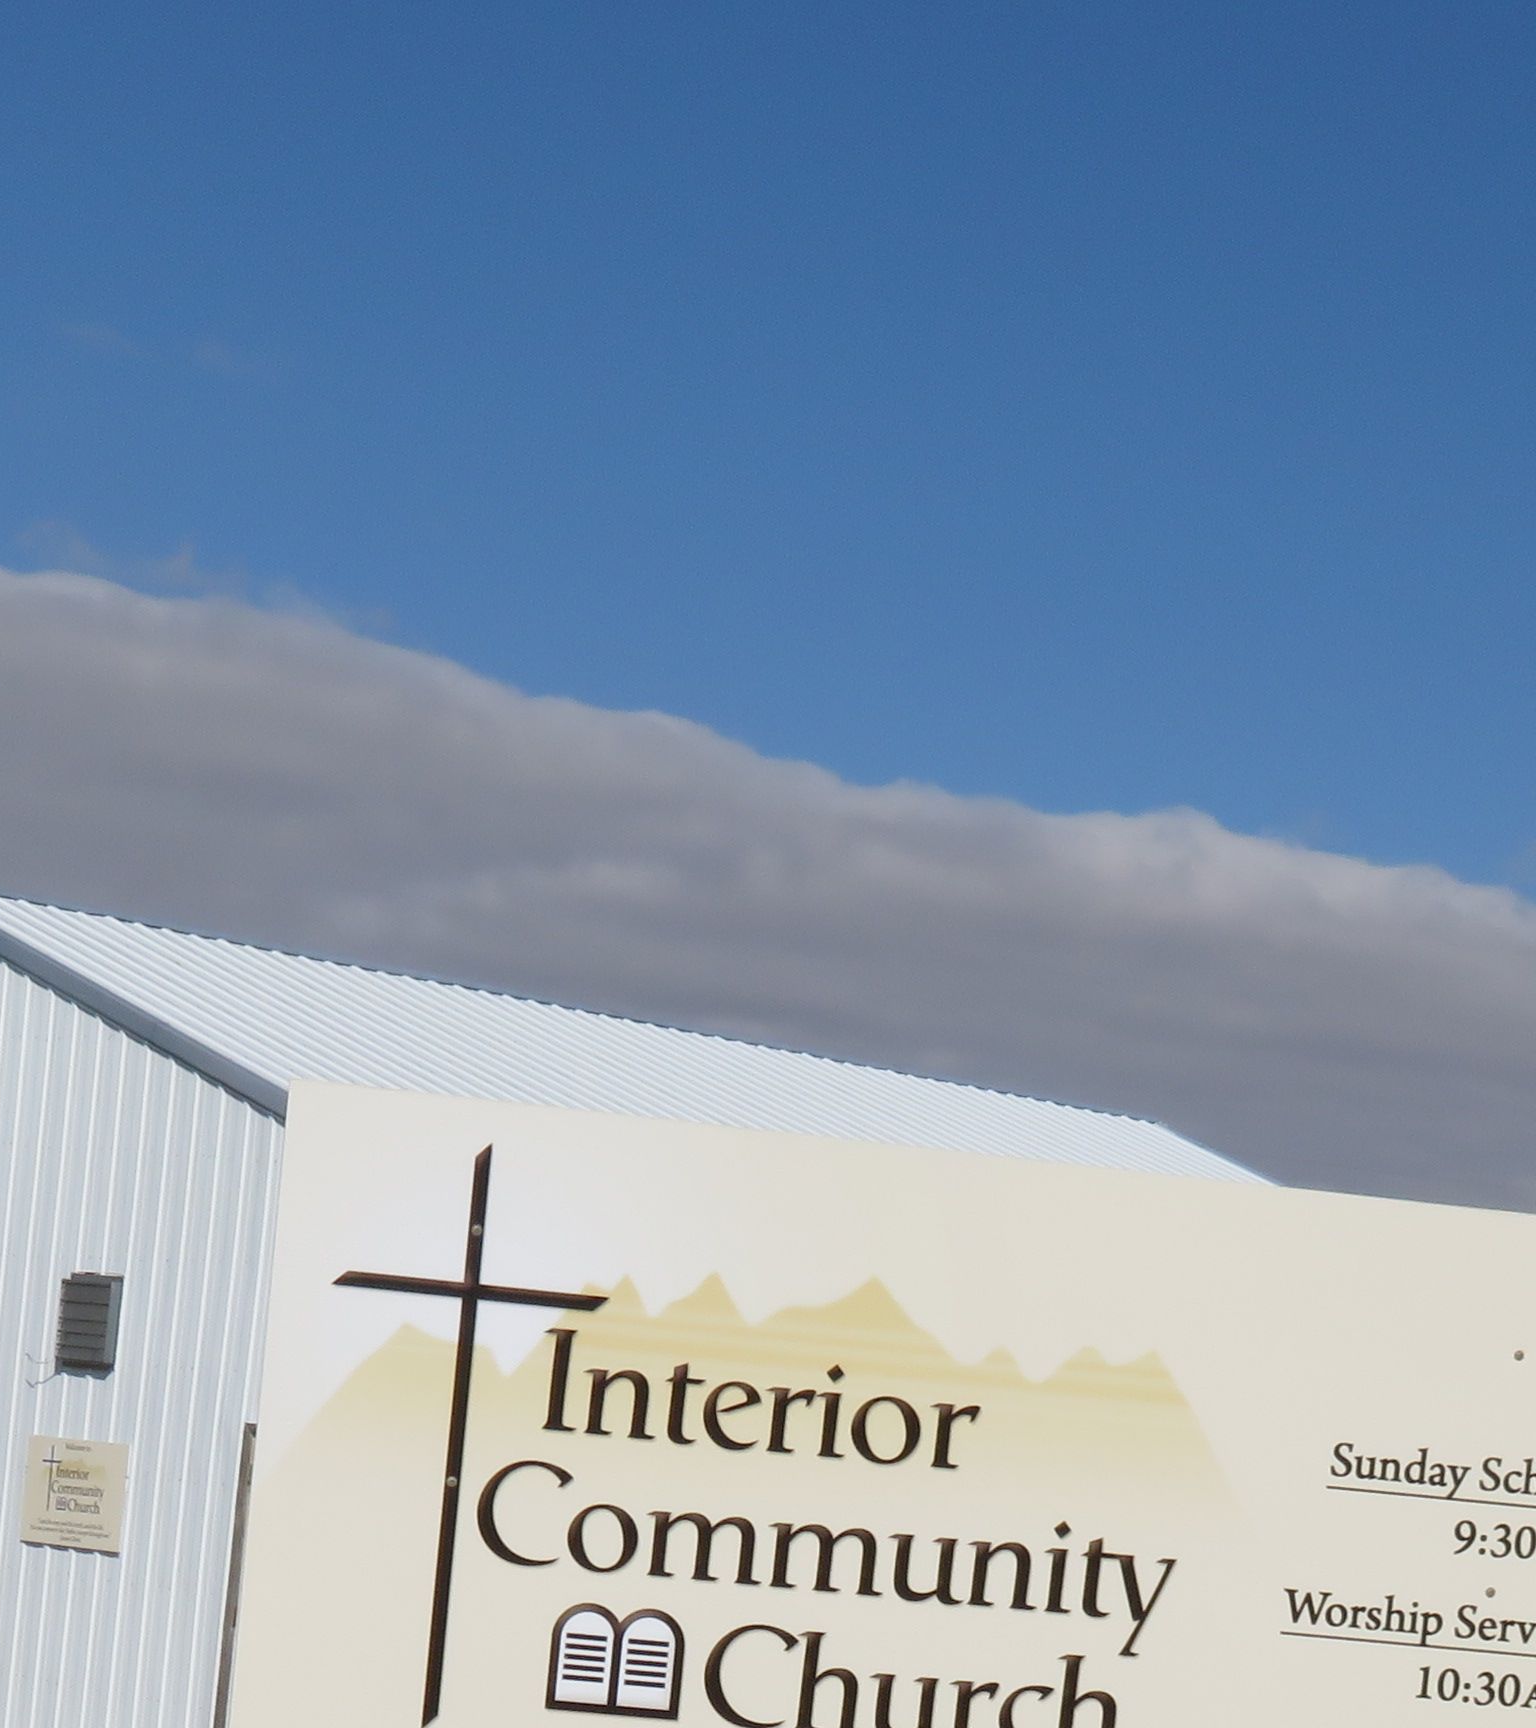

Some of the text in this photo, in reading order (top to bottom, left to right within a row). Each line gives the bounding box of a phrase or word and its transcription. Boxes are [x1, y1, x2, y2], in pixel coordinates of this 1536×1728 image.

[542, 1328, 981, 1470] Interior
[51, 1480, 104, 1502] Community
[56, 1465, 90, 1480] Interior
[1330, 1442, 1471, 1500] Sunday
[67, 1498, 101, 1515] Church
[476, 1460, 1177, 1658] Community
[1284, 1588, 1443, 1646] Worship
